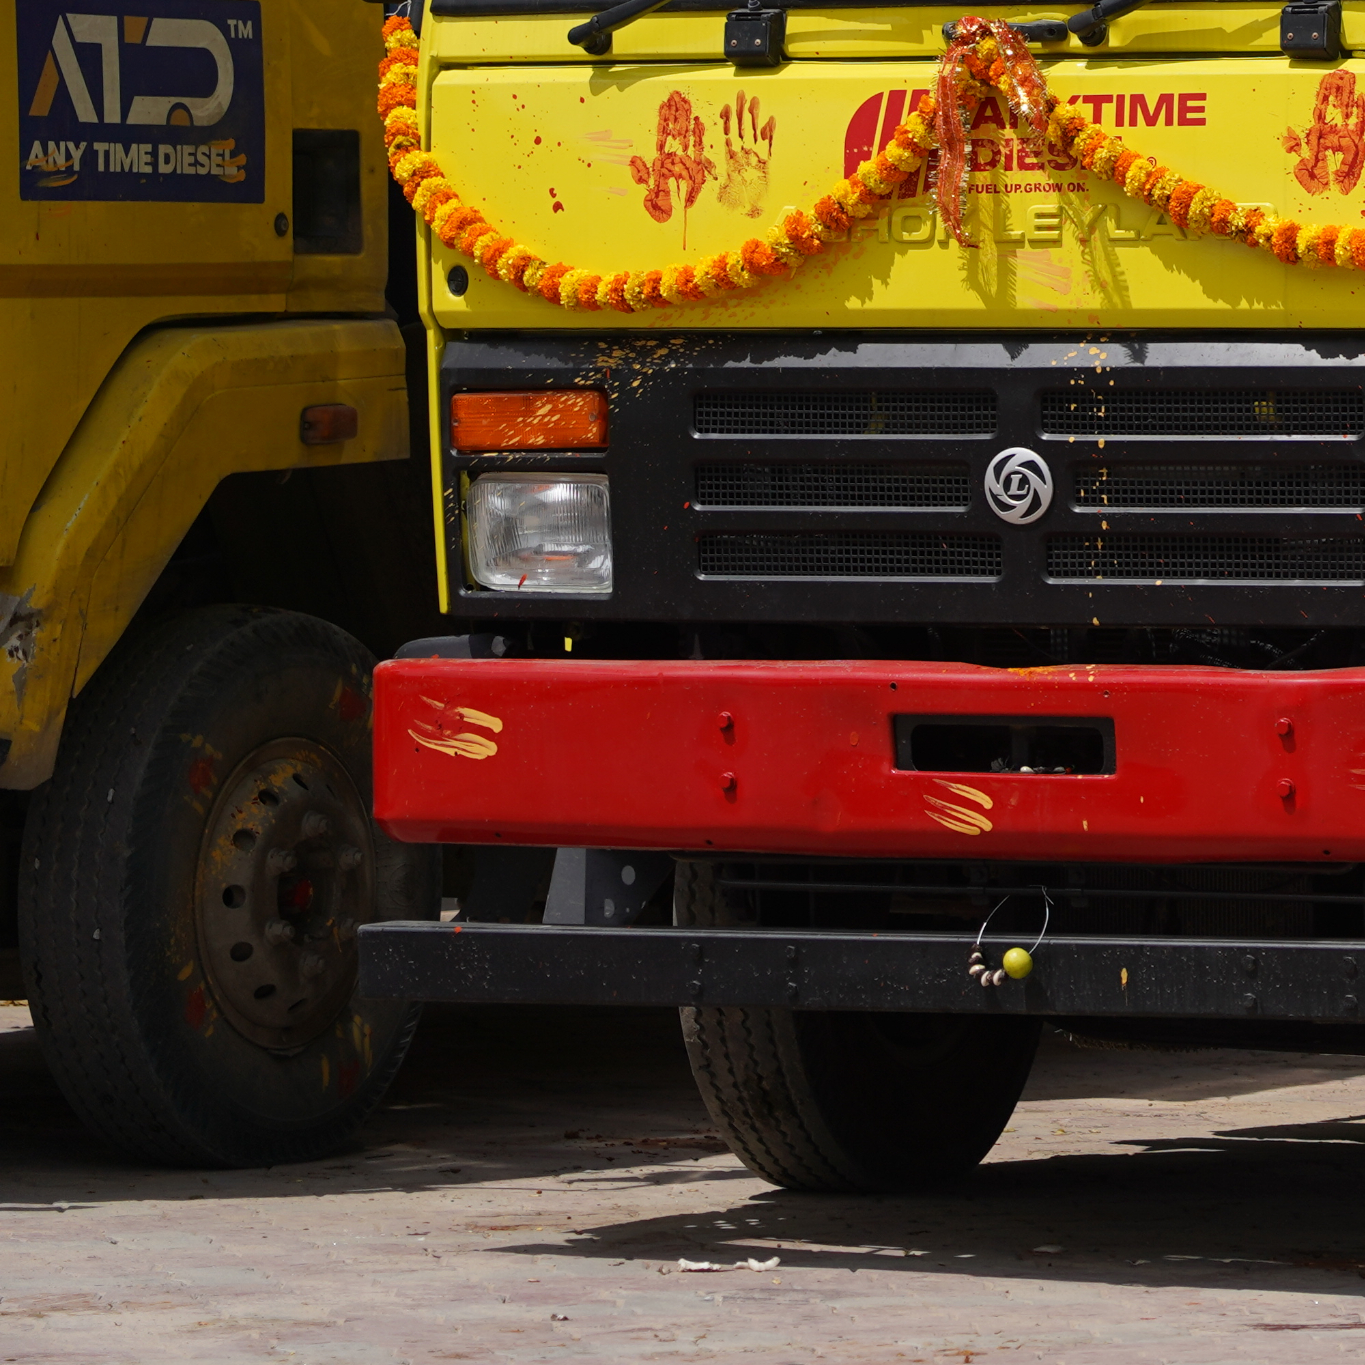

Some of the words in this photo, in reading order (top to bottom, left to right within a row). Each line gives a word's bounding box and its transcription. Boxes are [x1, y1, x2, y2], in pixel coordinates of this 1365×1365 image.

[29, 15, 234, 126] ATD
[227, 19, 253, 39] TM
[26, 140, 87, 171] ANY
[94, 142, 152, 174] TIME
[158, 144, 238, 176] DIESEL
[968, 184, 1000, 194] FUEL
[1067, 182, 1089, 193] ON.
